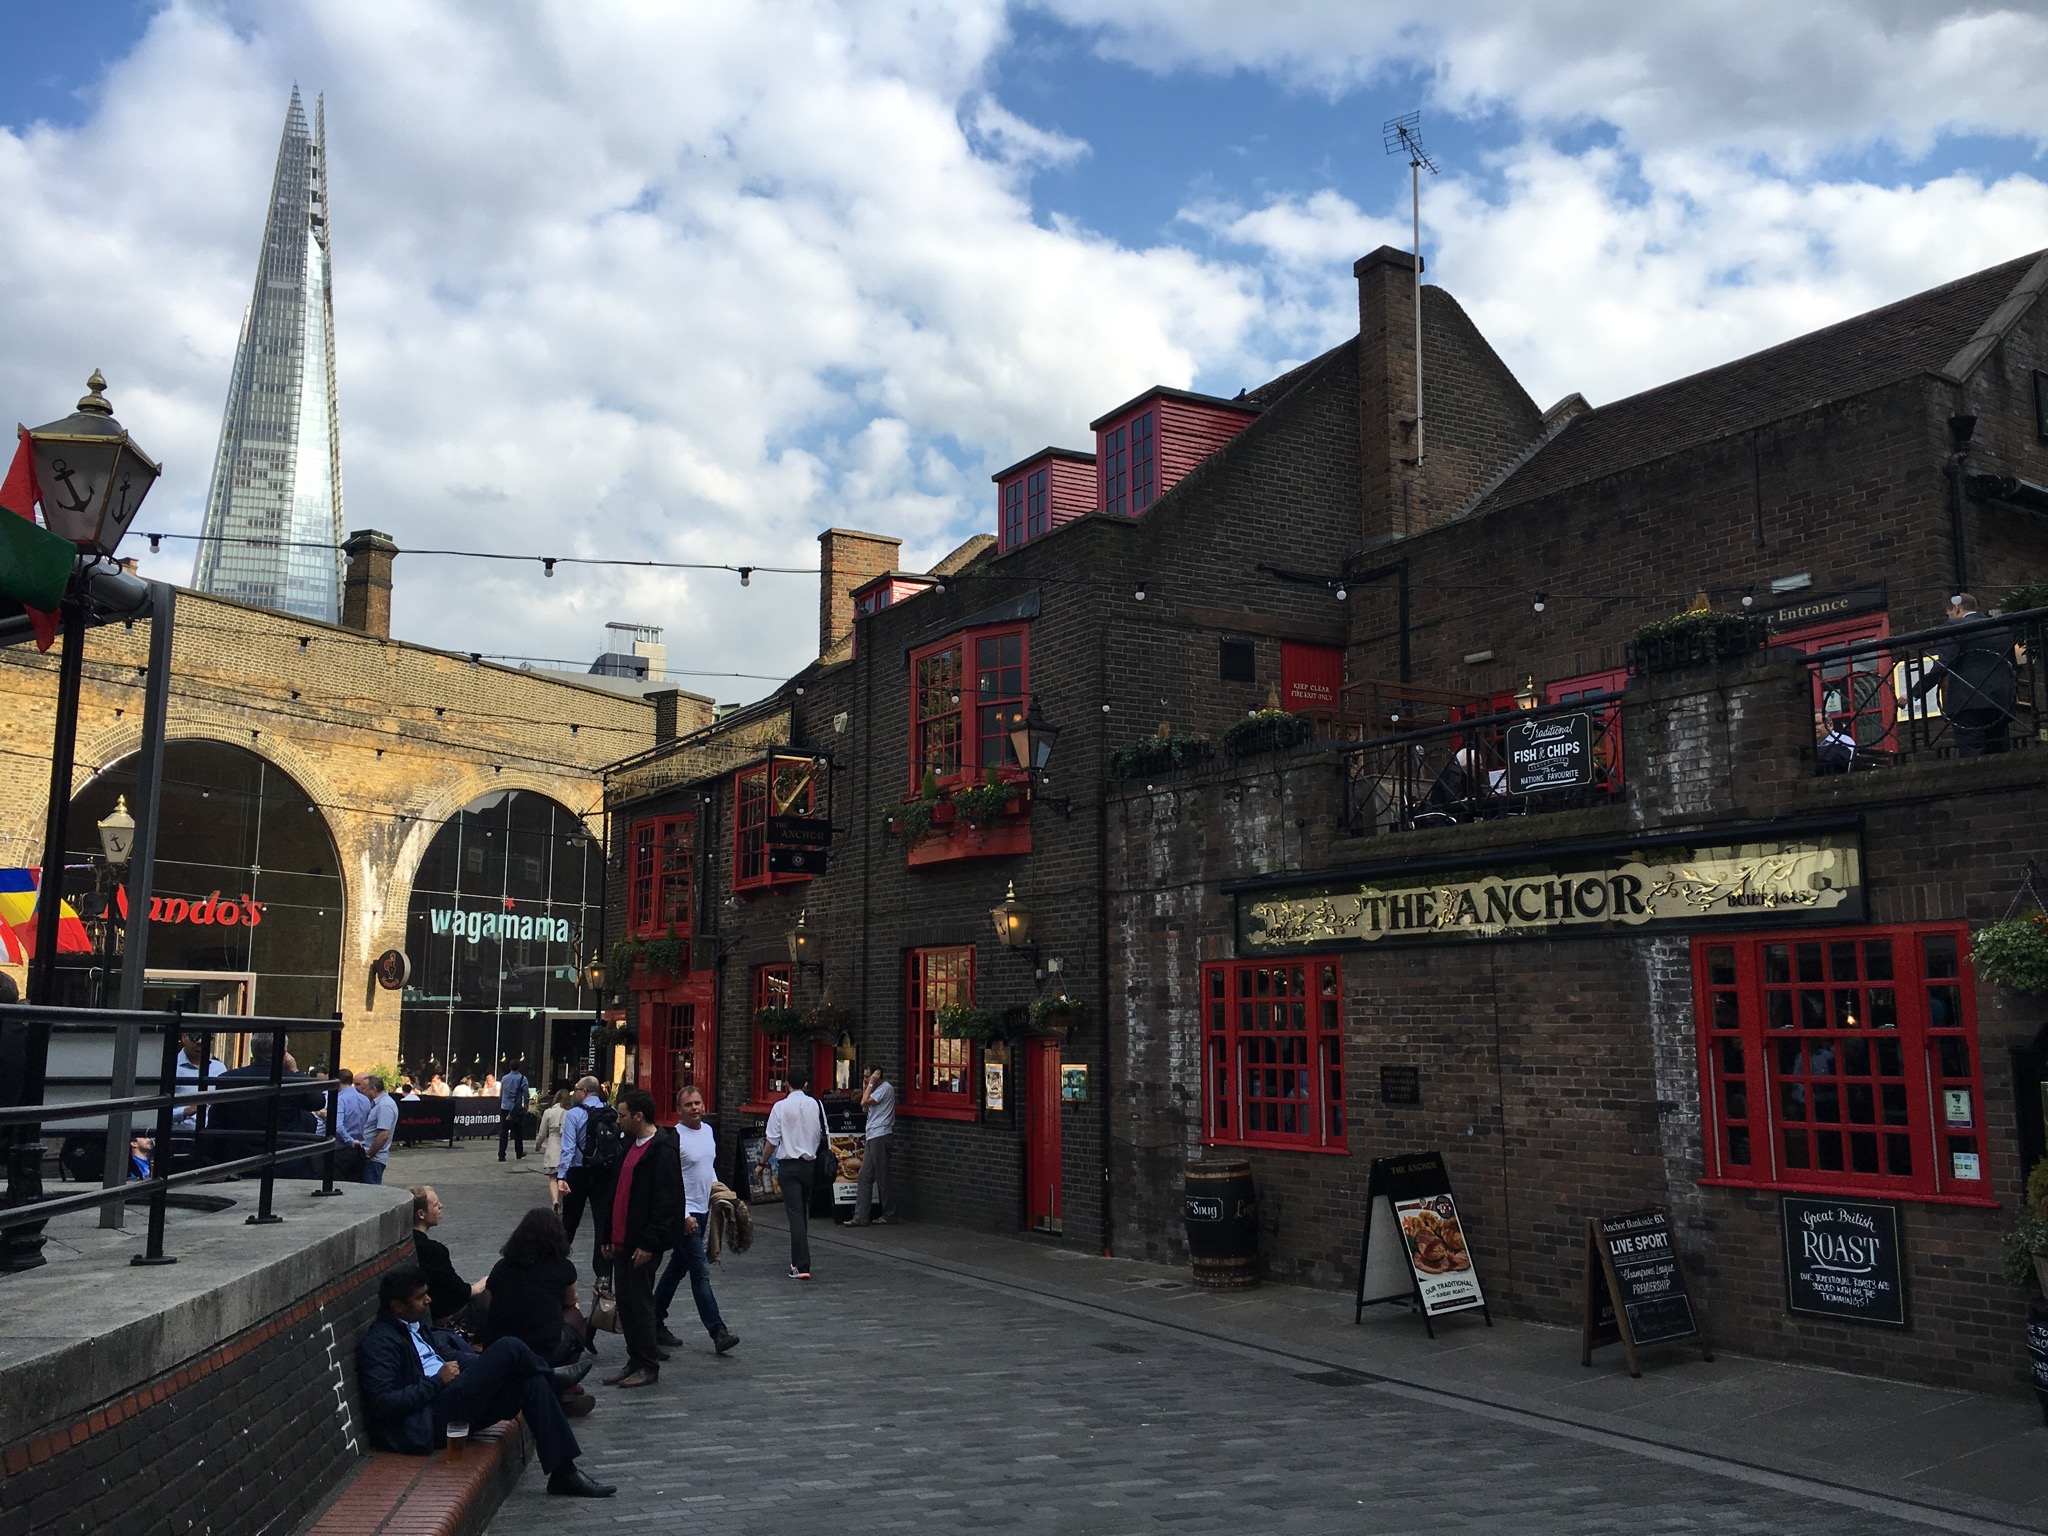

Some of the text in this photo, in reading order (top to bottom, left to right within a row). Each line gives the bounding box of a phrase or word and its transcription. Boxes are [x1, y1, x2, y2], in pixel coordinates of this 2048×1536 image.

[1778, 598, 1849, 622] Entrance
[1293, 682, 1330, 693] KEEP CLEAR
[1304, 691, 1317, 699] EXIT
[1317, 692, 1333, 700] ONLY
[1521, 718, 1573, 740] Traditional
[1514, 748, 1537, 763] FISH
[1547, 741, 1580, 758] CHIPS
[1521, 769, 1580, 785] NATIONS FAVOURITE
[781, 829, 824, 840] ANCHOR
[100, 883, 263, 927] ndo's
[1362, 873, 1647, 931] THE ANCHOR
[430, 908, 570, 944] wagamama
[1391, 1161, 1438, 1174] THE ANCHOR
[1193, 1201, 1218, 1219] Snug
[1603, 1221, 1626, 1233] Anchor
[1626, 1217, 1654, 1229] Bankside
[1800, 1207, 1877, 1233] Great British
[1610, 1232, 1668, 1255] LIVE SPORT
[1801, 1230, 1880, 1267] ROAST
[1621, 1267, 1655, 1281] Champions
[1655, 1263, 1675, 1278] League
[1425, 1280, 1474, 1295] OUR TRADITIONAL
[1632, 1279, 1671, 1295] PREMIERSHIP
[1800, 1272, 1812, 1281] OUR
[1878, 1280, 1890, 1291] ARE
[1812, 1282, 1835, 1292] SERVED
[1836, 1286, 1851, 1296] WITH
[1863, 1288, 1876, 1299] THE
